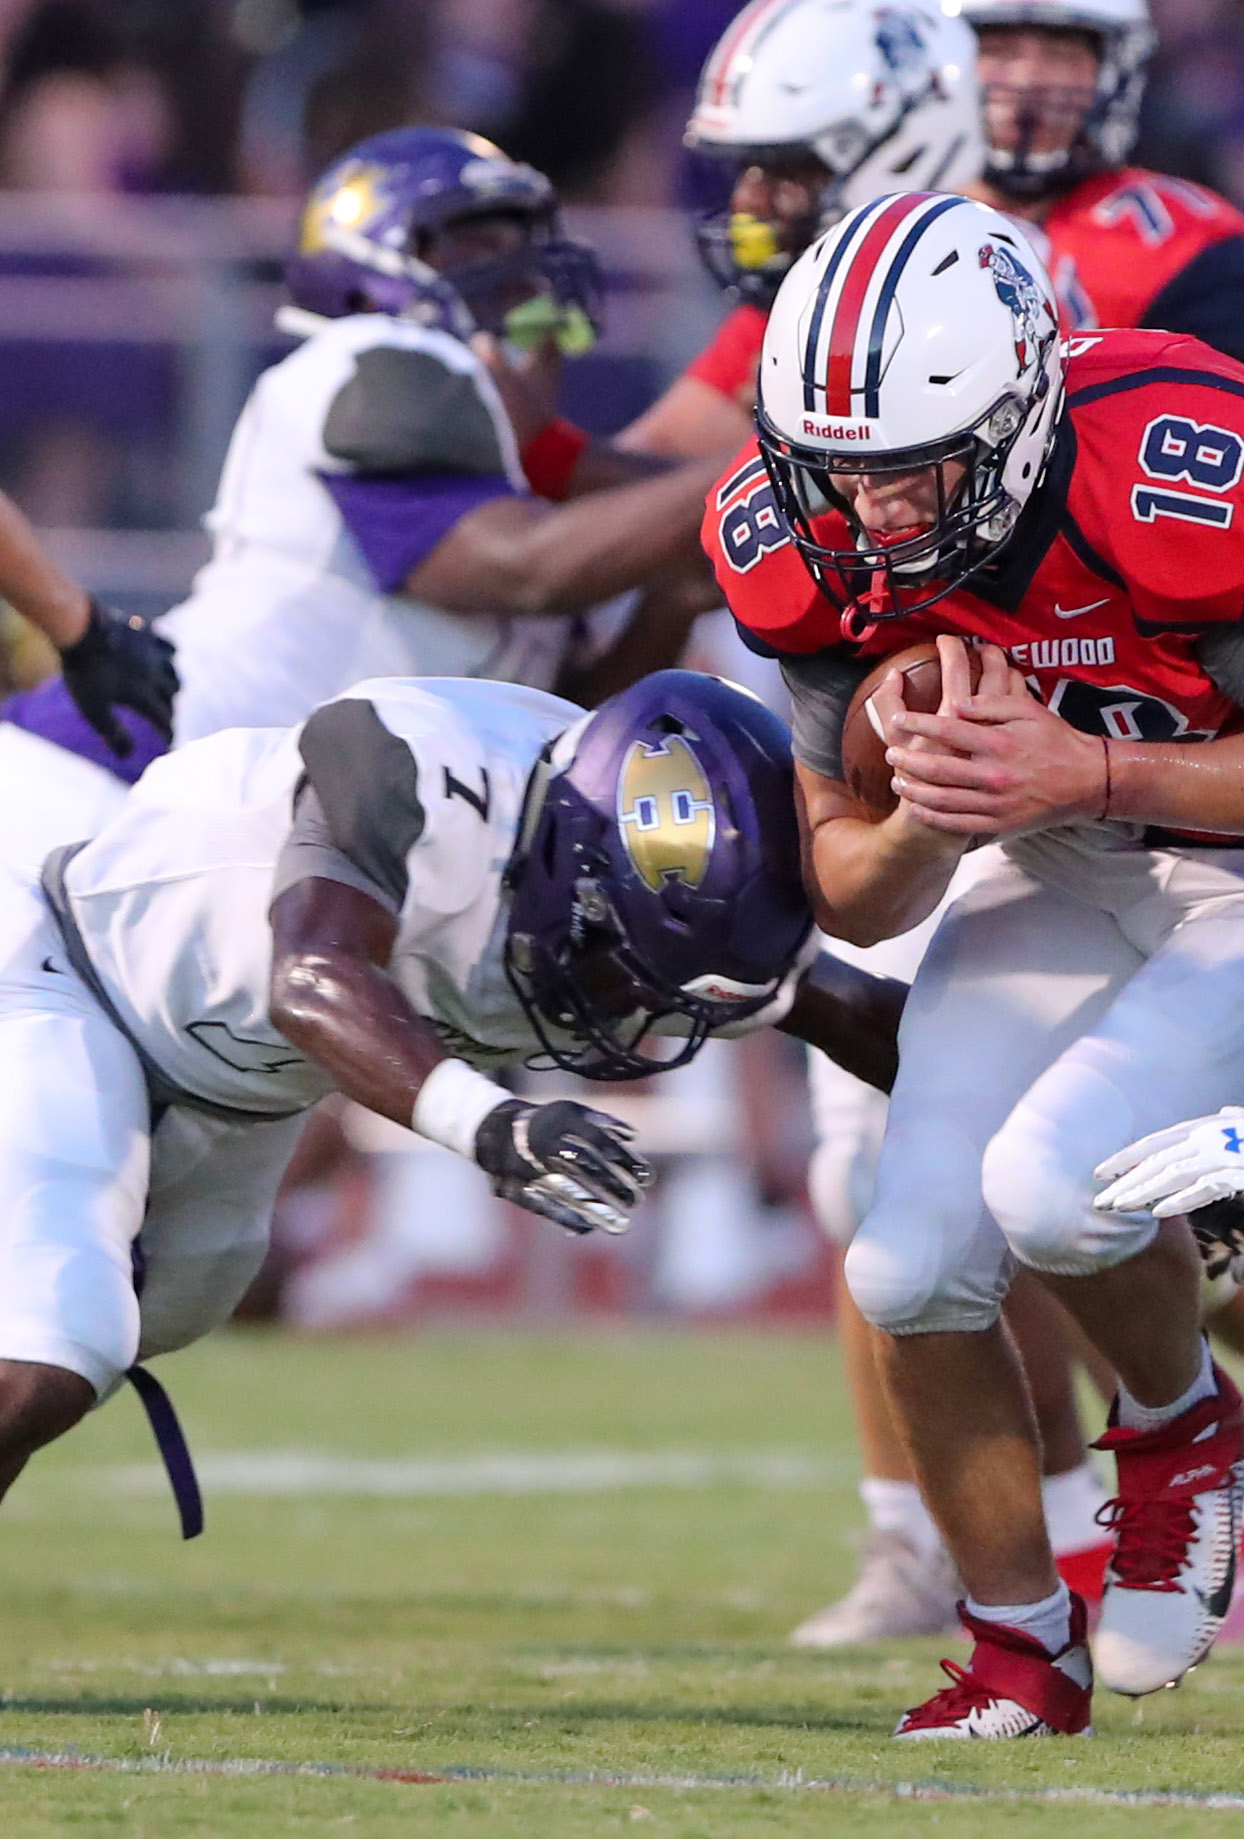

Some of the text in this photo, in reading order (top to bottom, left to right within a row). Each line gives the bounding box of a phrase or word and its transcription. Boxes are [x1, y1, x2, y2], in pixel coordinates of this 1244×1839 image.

[803, 419, 870, 440] Riddell
[716, 454, 792, 574] 18
[441, 765, 489, 824] 7
